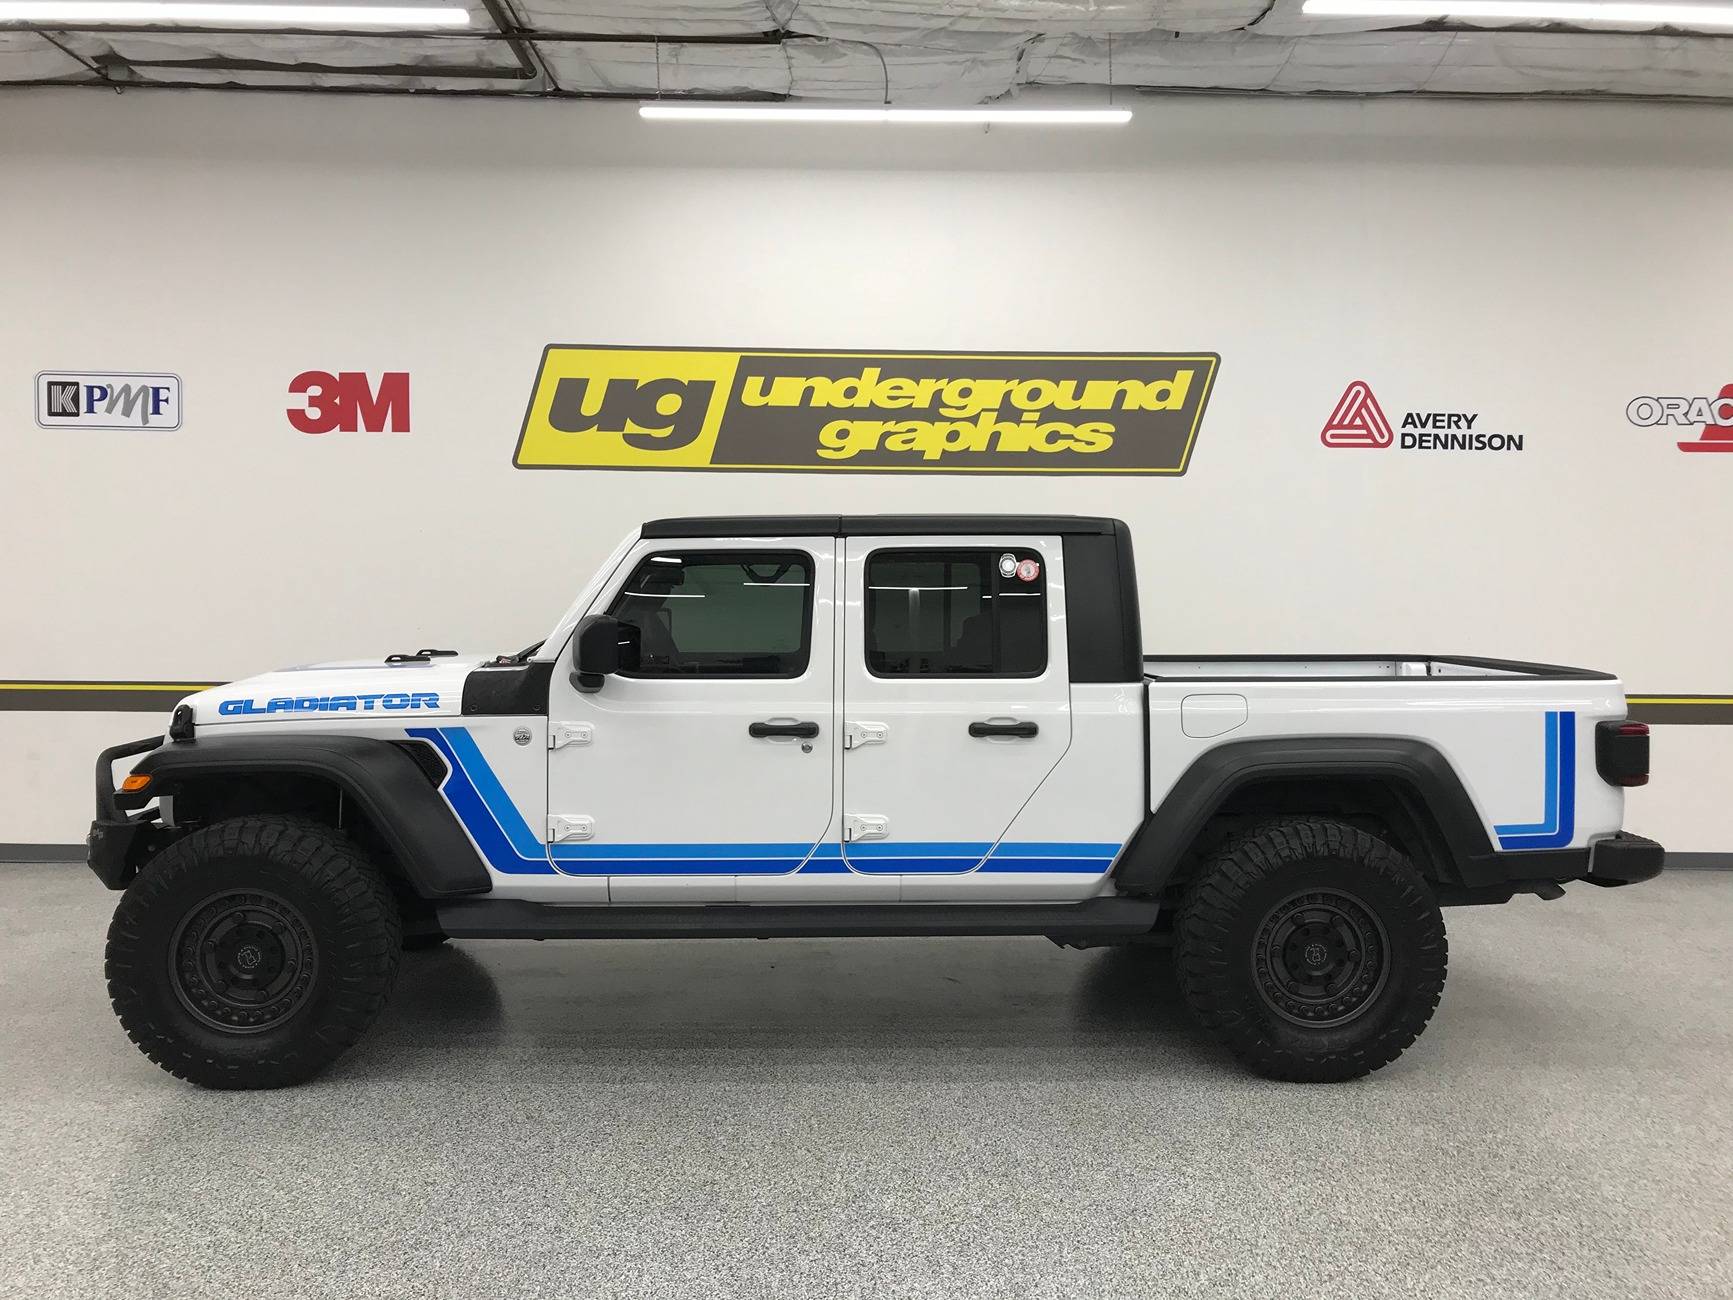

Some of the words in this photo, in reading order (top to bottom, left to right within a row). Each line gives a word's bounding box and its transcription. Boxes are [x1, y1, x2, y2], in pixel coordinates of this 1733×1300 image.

[286, 370, 411, 434] 3M
[548, 377, 716, 451] ug
[741, 368, 1194, 417] underground
[817, 413, 1114, 459] graphics
[1400, 432, 1524, 451] DENNISON
[1401, 412, 1479, 430] AVERY
[218, 692, 440, 715] GLADIATOR
